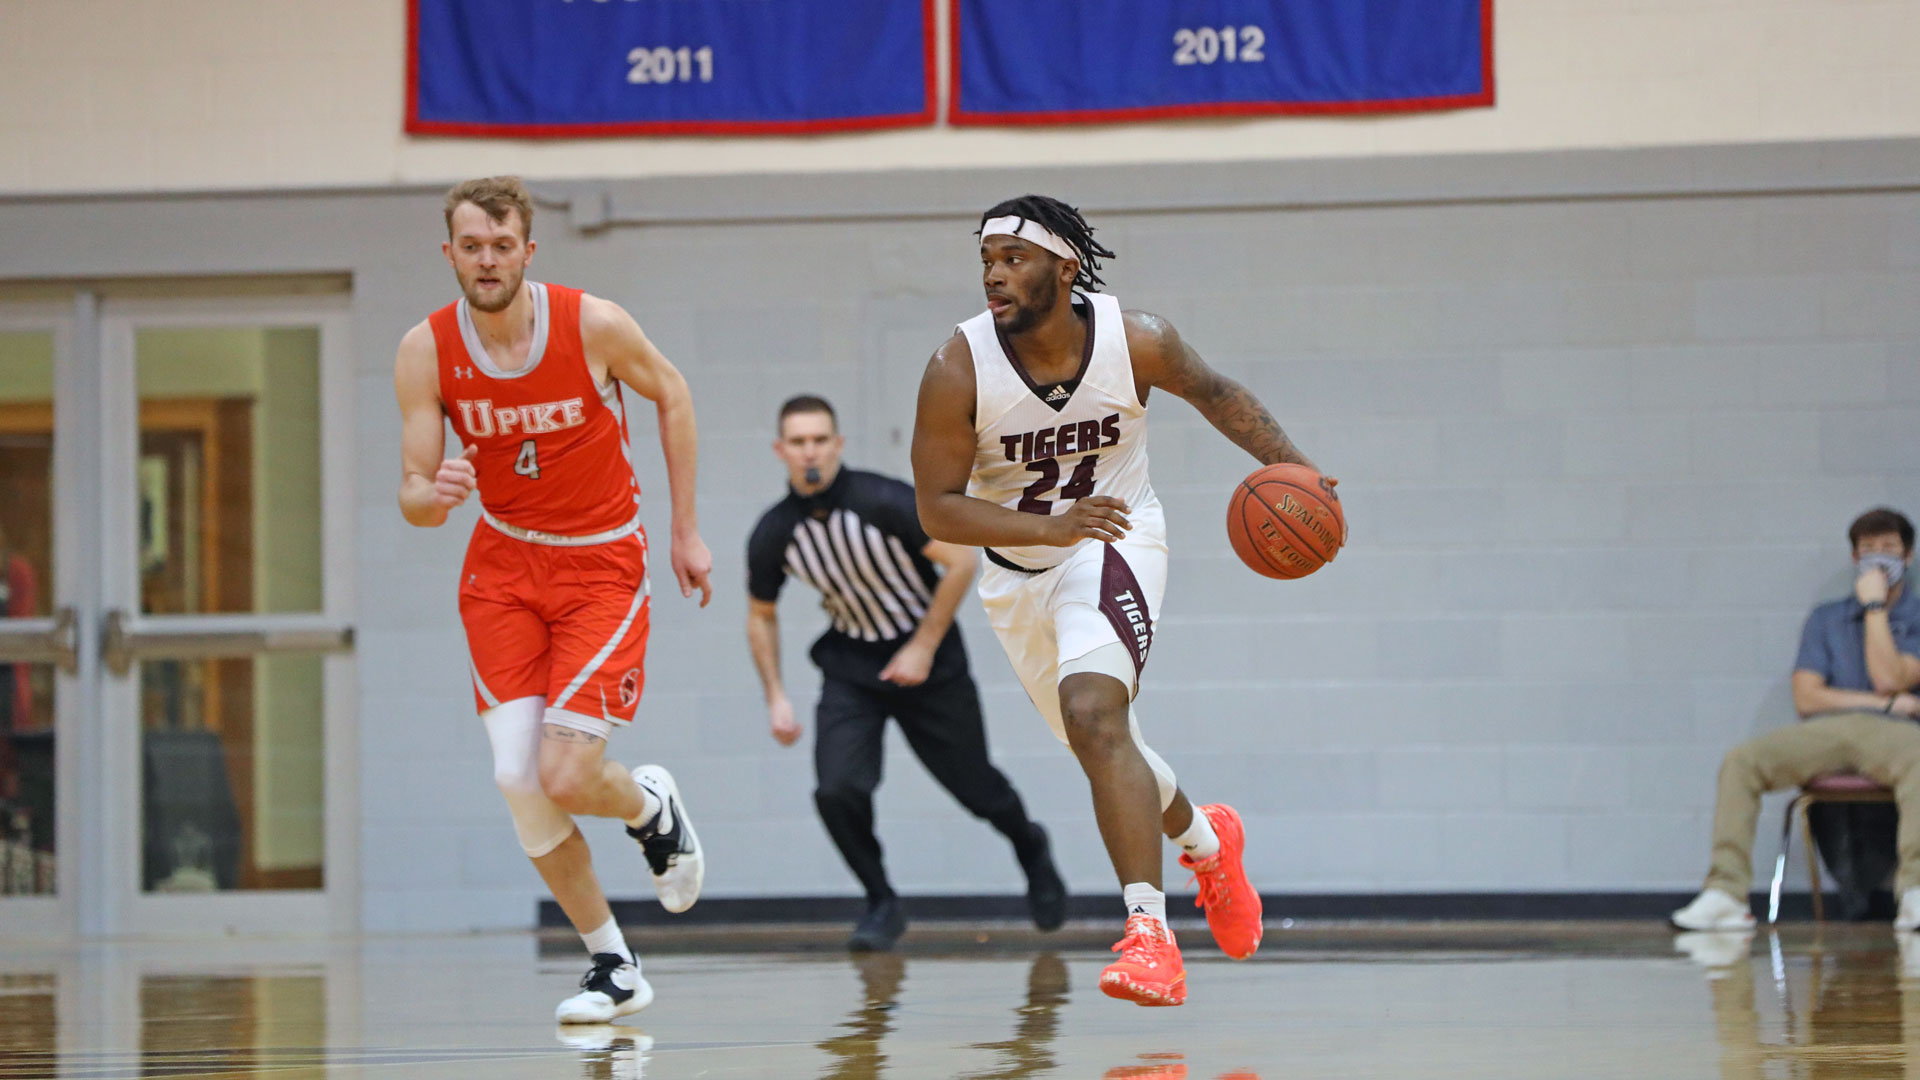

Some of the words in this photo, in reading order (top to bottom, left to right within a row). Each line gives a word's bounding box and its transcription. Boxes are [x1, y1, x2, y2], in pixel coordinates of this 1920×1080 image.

[626, 46, 713, 84] 2011
[1173, 24, 1265, 65] 2012
[1045, 392, 1071, 402] adidas
[1000, 413, 1121, 463] TIGERS
[514, 440, 541, 480] 4
[1018, 454, 1100, 515] 24
[1276, 493, 1337, 553] SPALDING
